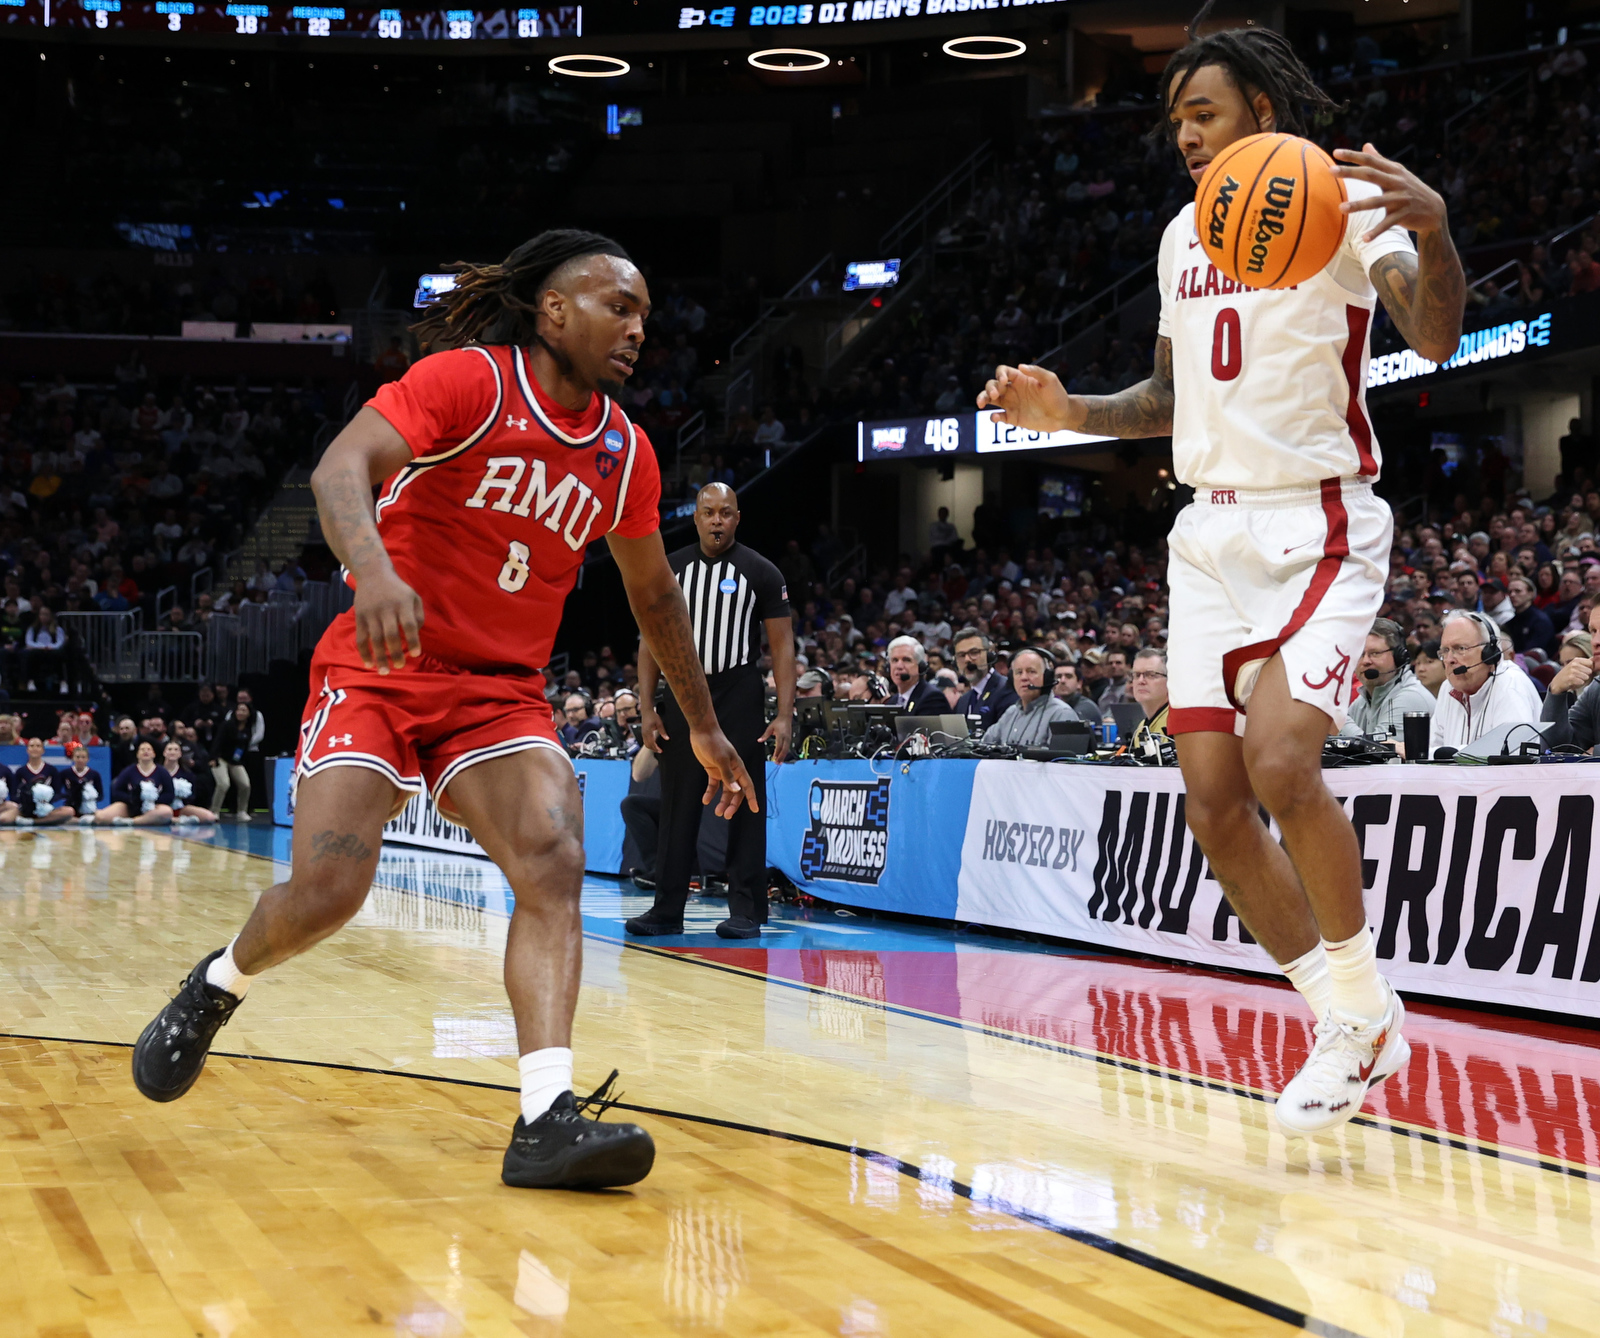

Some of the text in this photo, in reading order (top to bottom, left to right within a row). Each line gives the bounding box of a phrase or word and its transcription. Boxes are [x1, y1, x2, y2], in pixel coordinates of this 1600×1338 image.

[95, 9, 108, 29] 5
[308, 18, 330, 37] 22
[378, 20, 401, 38] 50
[449, 21, 472, 39] 33
[749, 5, 813, 26] 2025
[818, 2, 848, 23] DI
[851, 0, 920, 21] MEN'S
[1208, 175, 1240, 250] NCAA
[1246, 176, 1296, 273] Wilson
[1175, 262, 1297, 302] ALAB
[1211, 307, 1242, 382] 0
[924, 418, 959, 452] 46
[465, 455, 603, 552] RMU
[1211, 490, 1238, 505] RTR
[497, 540, 531, 594] 8
[820, 789, 867, 827] MARCH
[825, 827, 887, 868] MADNESS
[982, 819, 1085, 872] HOSTED BY
